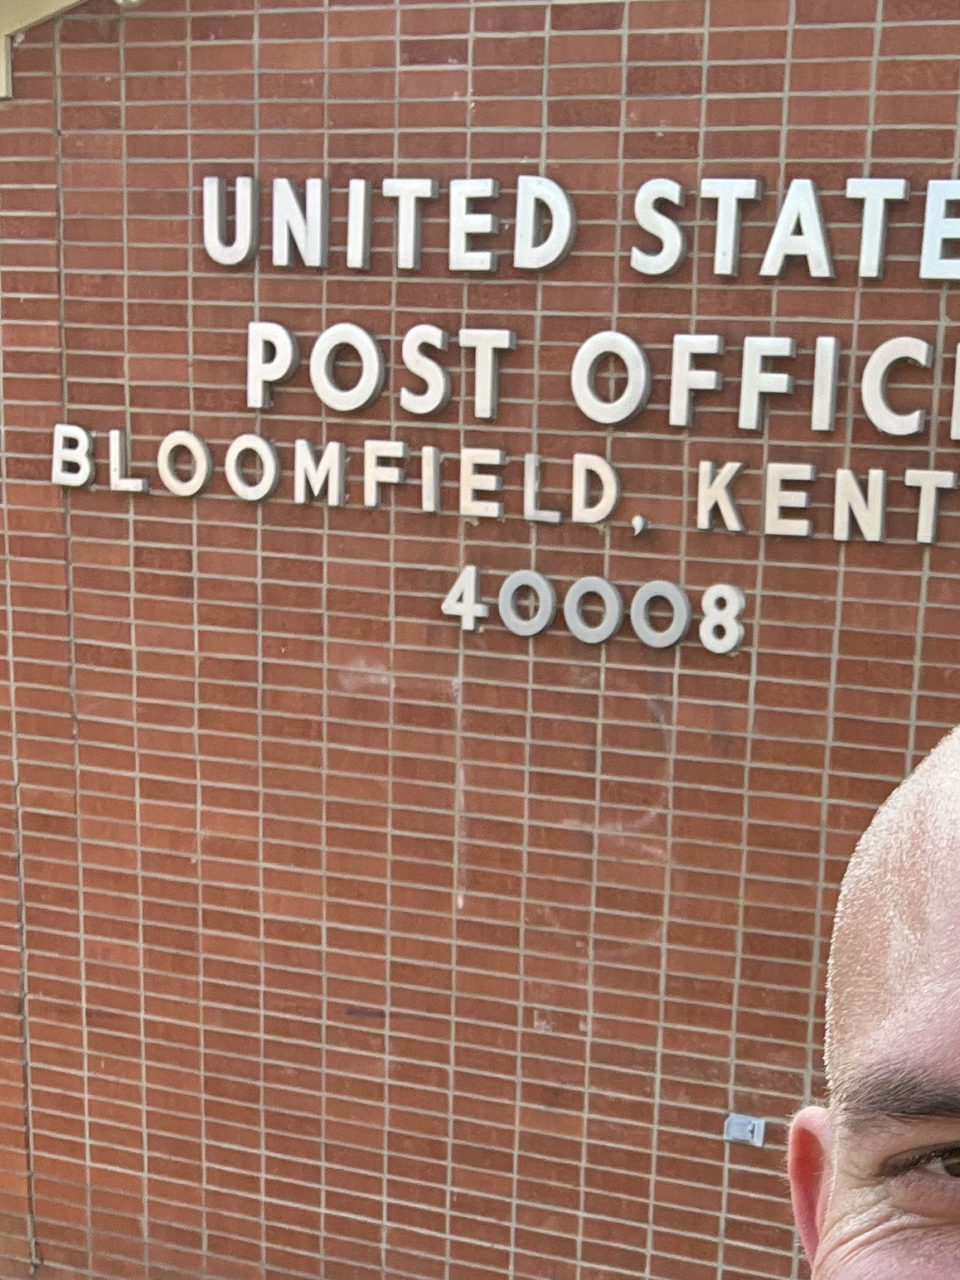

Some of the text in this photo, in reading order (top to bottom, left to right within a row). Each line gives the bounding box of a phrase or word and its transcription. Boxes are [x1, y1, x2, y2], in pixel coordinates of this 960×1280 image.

[202, 175, 577, 272] UNITED
[246, 321, 516, 420] POST
[51, 422, 649, 536] BLOOMFIELD,
[440, 564, 746, 655] 40008
